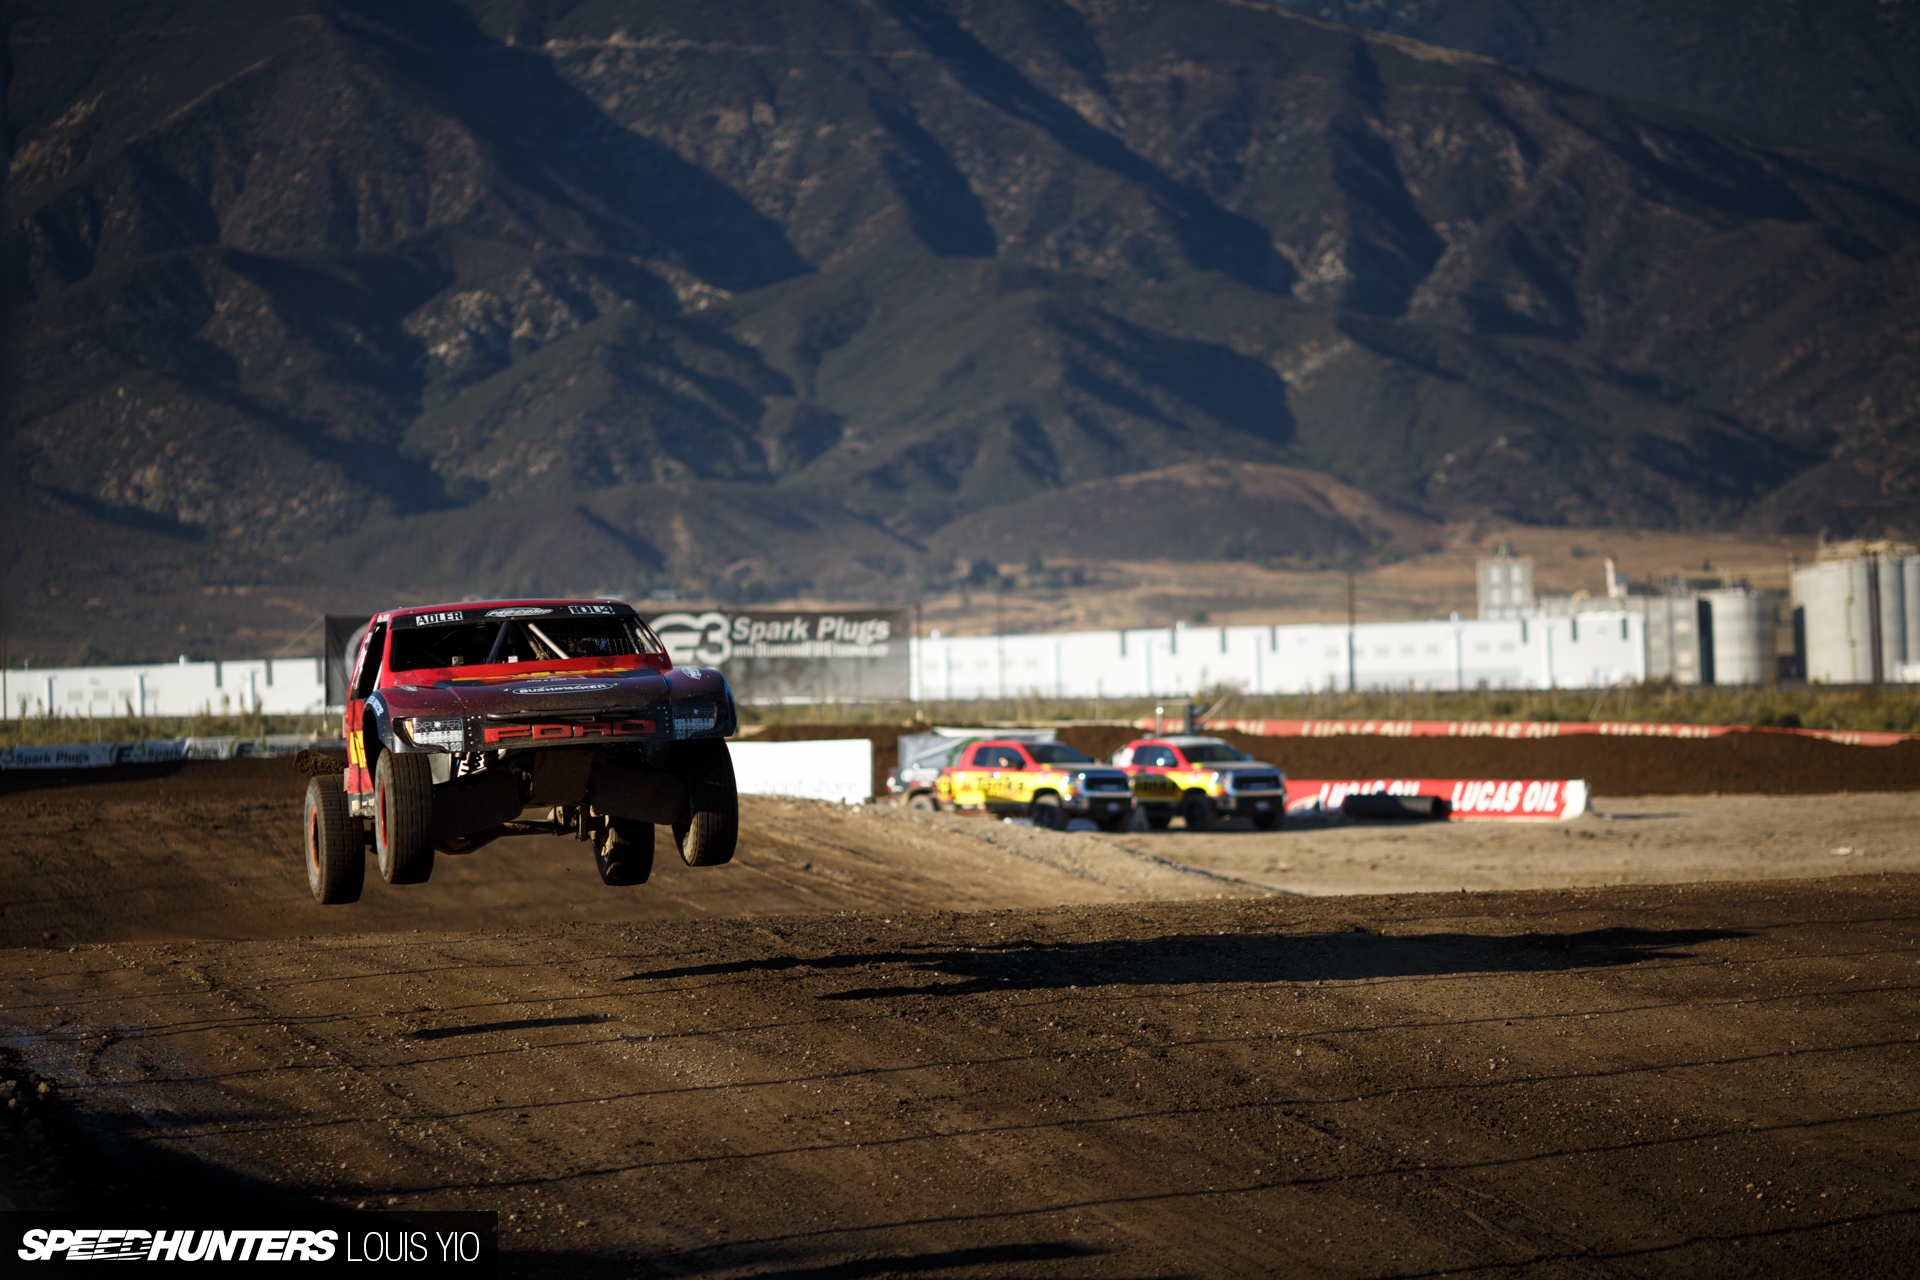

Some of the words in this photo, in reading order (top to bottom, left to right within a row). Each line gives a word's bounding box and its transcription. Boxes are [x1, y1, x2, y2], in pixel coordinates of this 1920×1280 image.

[416, 612, 463, 625] ADLER
[732, 616, 809, 644] Spark
[816, 616, 891, 645] Plugs
[484, 719, 656, 743] FORD
[16, 751, 52, 769] Spark
[56, 750, 90, 765] Plugs
[1451, 780, 1523, 812] LUCAS
[1522, 780, 1560, 812] OIL
